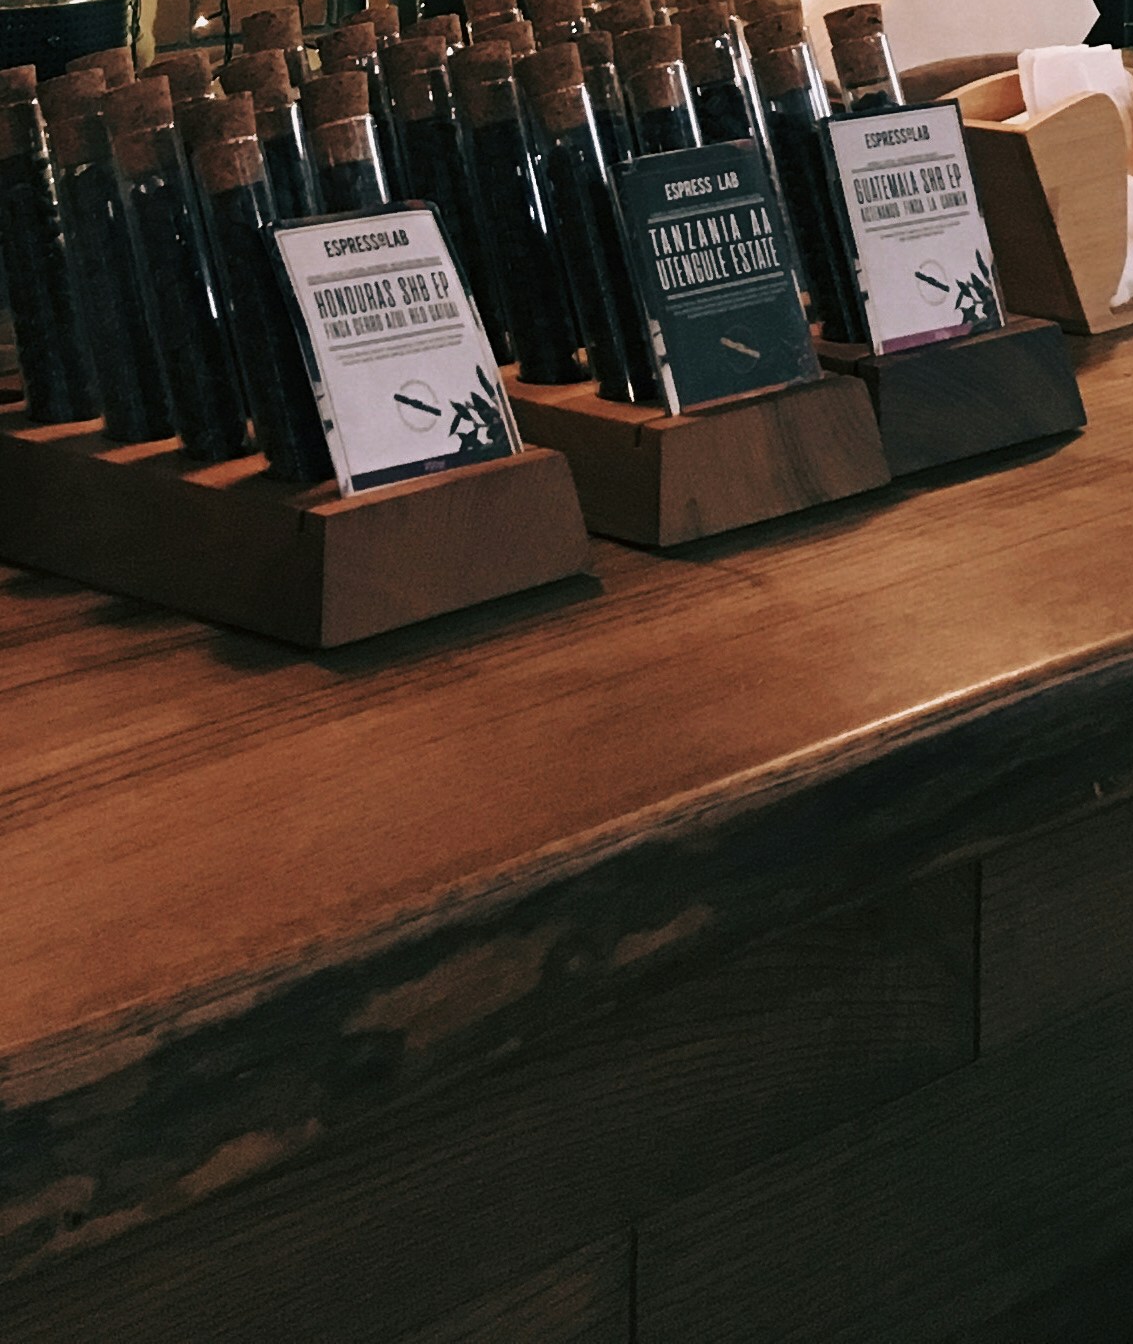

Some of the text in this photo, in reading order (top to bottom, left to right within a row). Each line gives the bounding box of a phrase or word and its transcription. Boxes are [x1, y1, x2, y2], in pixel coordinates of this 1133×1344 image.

[853, 163, 962, 204] GUATEMALA SHB EP
[648, 207, 773, 257] TANZANIA AA
[655, 236, 780, 291] UTENGULE ESTATE
[314, 279, 396, 319] HONDURAS
[397, 272, 430, 306] SHB
[431, 271, 449, 300] EP
